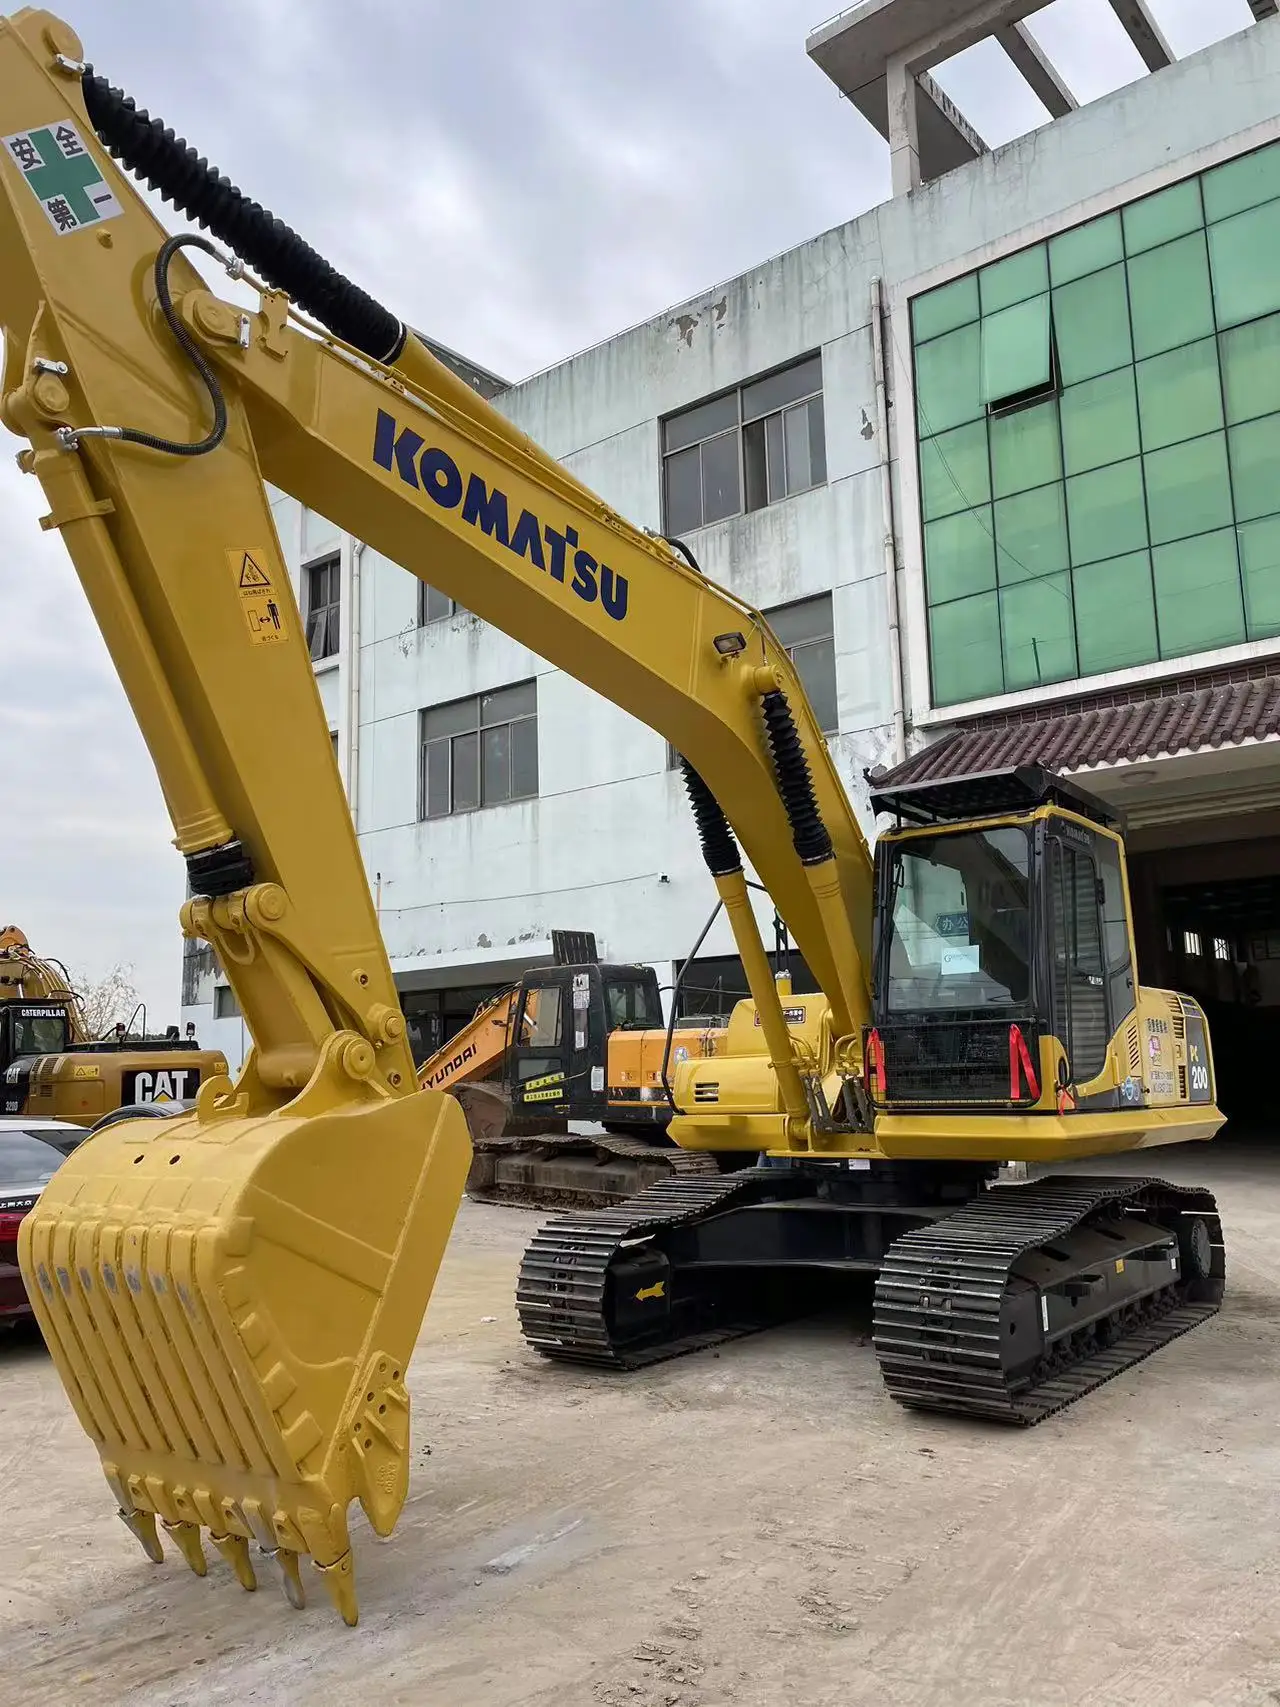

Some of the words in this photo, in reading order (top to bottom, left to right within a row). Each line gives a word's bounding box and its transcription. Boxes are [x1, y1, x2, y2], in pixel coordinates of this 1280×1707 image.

[373, 408, 628, 621] KOMATSU
[21, 1009, 66, 1017] CATERPILLAR
[135, 1070, 188, 1105] CAT
[1192, 1065, 1208, 1089] 200
